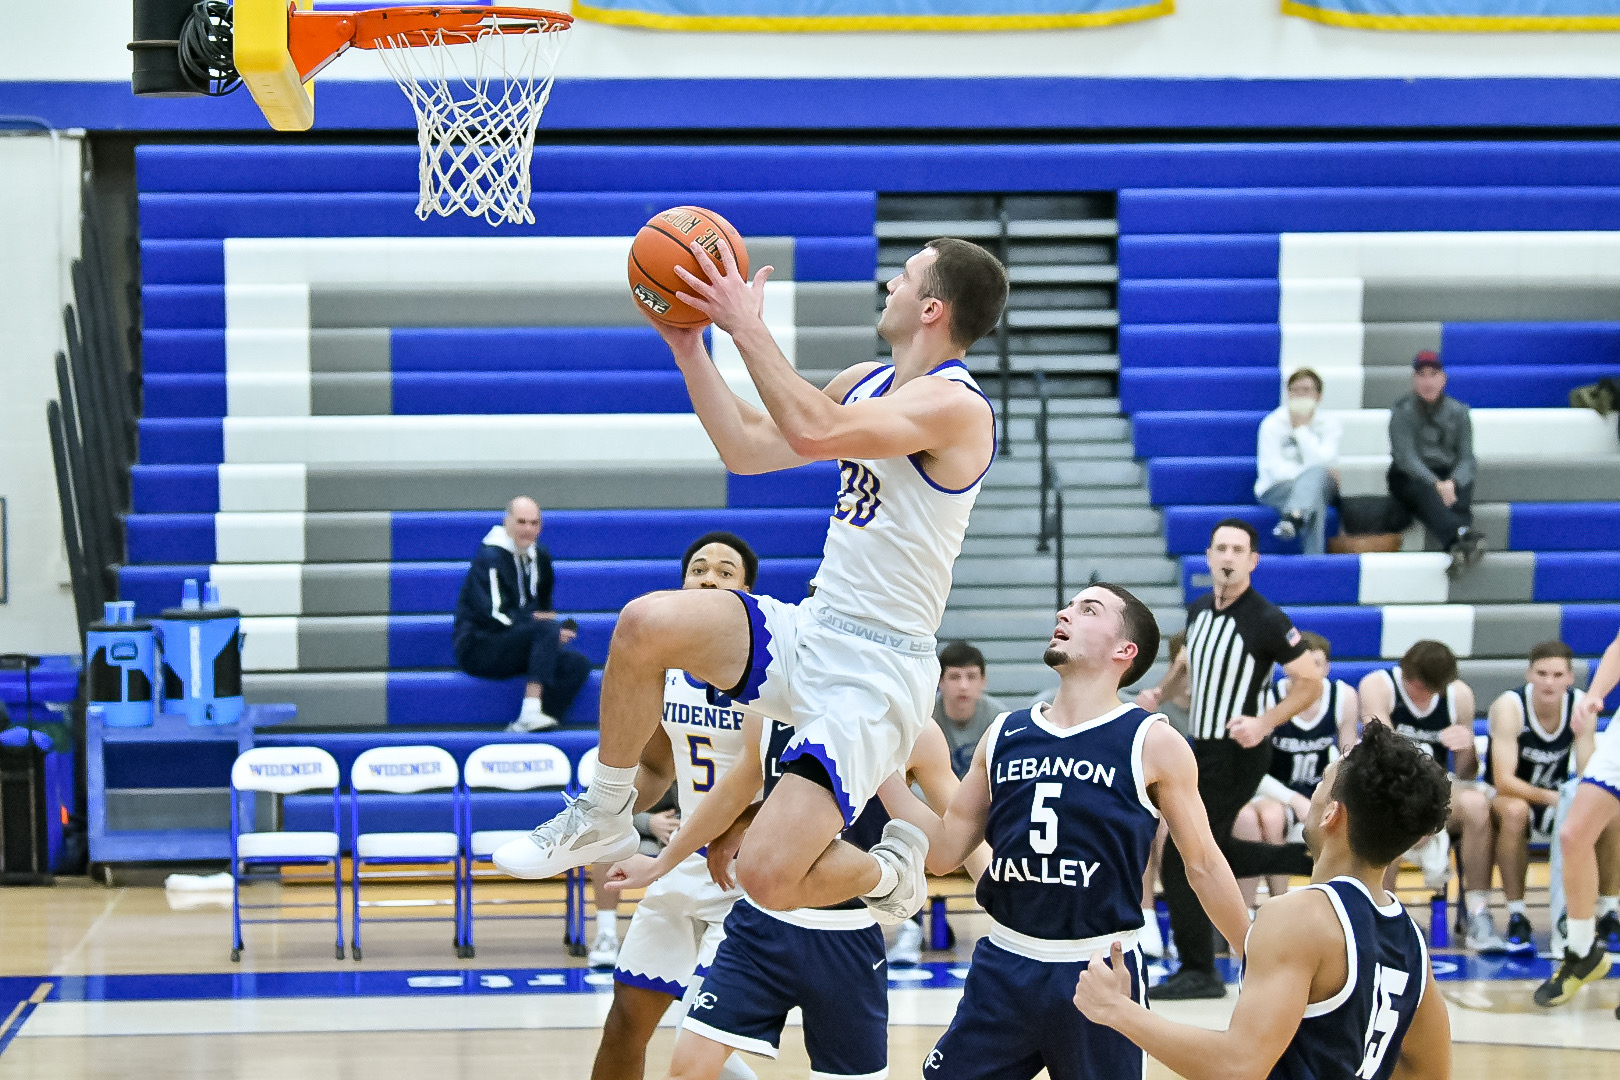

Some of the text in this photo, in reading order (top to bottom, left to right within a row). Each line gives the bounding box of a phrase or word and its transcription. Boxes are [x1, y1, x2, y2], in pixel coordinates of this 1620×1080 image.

[634, 287, 667, 314] MAC
[836, 458, 882, 529] 20
[249, 761, 323, 777] WIDENER
[368, 761, 442, 777] WIDENER
[481, 759, 554, 775] WIDENER
[686, 733, 716, 793] 5
[996, 756, 1117, 788] LEBANON
[1029, 782, 1063, 855] 5
[989, 857, 1101, 888] VALLEY
[1355, 962, 1410, 1080] 15
